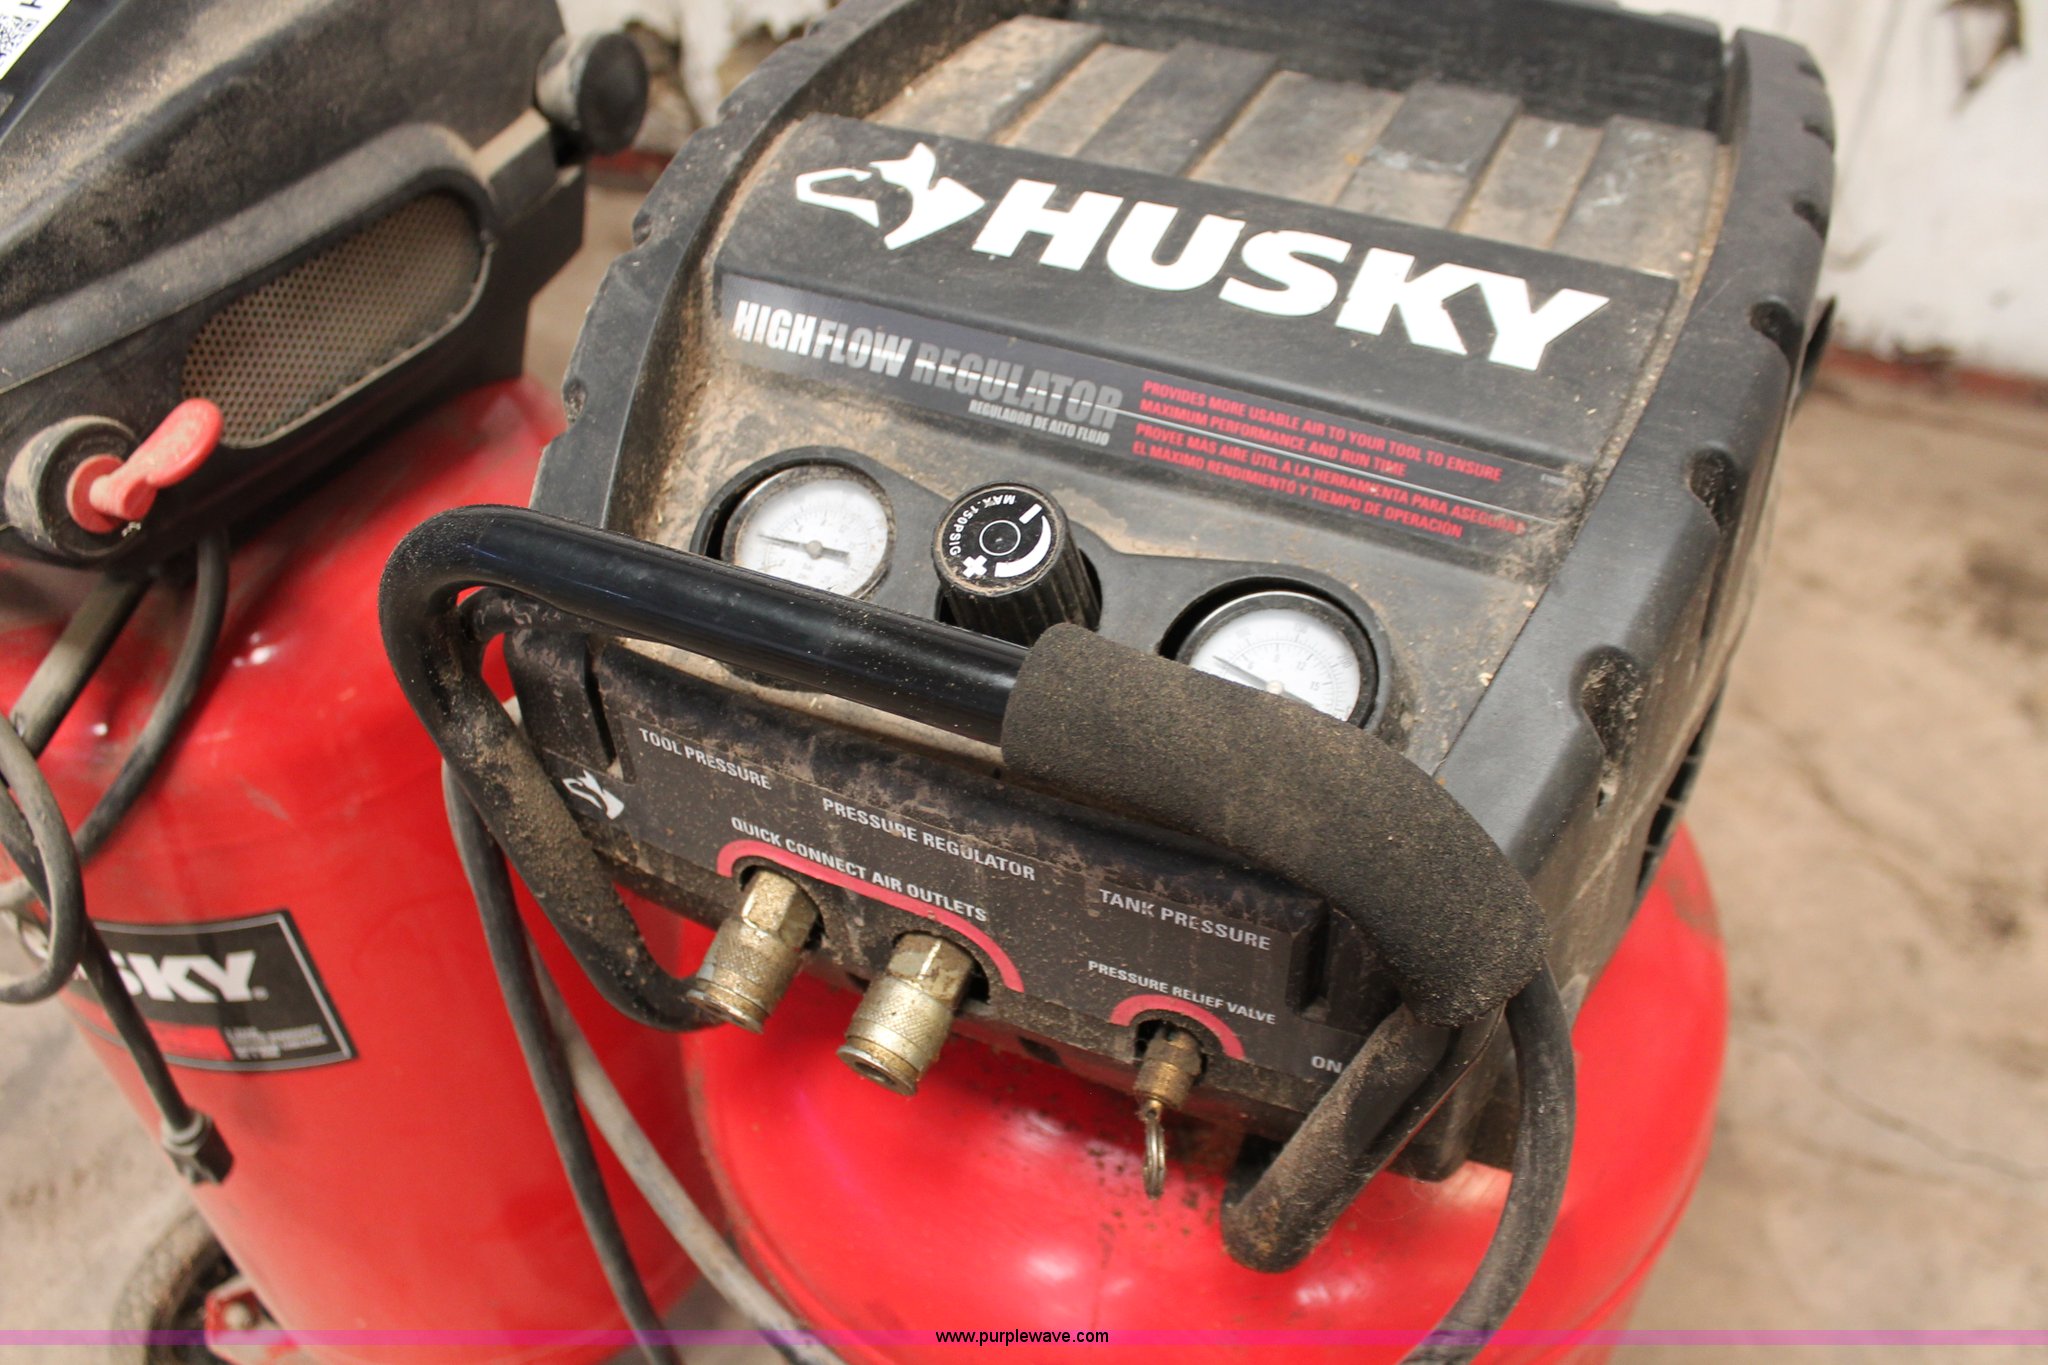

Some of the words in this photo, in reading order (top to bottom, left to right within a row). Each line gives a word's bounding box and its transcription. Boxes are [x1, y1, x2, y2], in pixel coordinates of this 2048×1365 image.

[971, 178, 1610, 372] HUSKY
[909, 342, 1124, 431] REGULATOR
[967, 398, 1033, 428] REGULADOR
[1033, 414, 1049, 430] DE
[1048, 418, 1076, 438] ALTO
[1076, 424, 1110, 447] FLUJO
[1135, 421, 1184, 447] PROVEE
[1218, 443, 1249, 463] AIRE
[1280, 459, 1292, 474] A
[1293, 462, 1311, 479] LA
[1311, 467, 1409, 505] HERRAMIENTA
[1410, 492, 1449, 516] PARA
[1139, 398, 1209, 427] MAXIMUM
[1209, 415, 1308, 452] PERFORMANCE
[1307, 440, 1340, 460] AND
[1339, 447, 1371, 469] RUN
[1372, 455, 1408, 478] TIME
[1141, 379, 1207, 408] PROVIDES
[1207, 395, 1248, 418] MORE
[1248, 406, 1300, 431] USABLE
[1301, 418, 1327, 438] AIR
[1328, 425, 1345, 442] TO
[1349, 430, 1387, 452] YOUR
[1388, 439, 1423, 463] TOOL
[1426, 449, 1444, 467] TO
[1445, 455, 1504, 483] ENSURE
[1132, 440, 1147, 457] EL
[1206, 459, 1297, 495] RENDIMIENTO
[1298, 482, 1309, 497] Y
[1311, 485, 1362, 512] TIEMPO
[1363, 501, 1383, 517] DE
[948, 505, 980, 557] 150PSIG
[638, 727, 683, 756] TOOL
[684, 745, 772, 790] PRESSURE
[730, 816, 782, 848] QUICK
[785, 838, 867, 880] CONNECT
[872, 871, 903, 893] AIR
[906, 883, 988, 923] OUTLETS
[822, 797, 919, 843] PRESSURE
[922, 831, 1036, 881] REGULATOR
[1098, 888, 1155, 919] TANK
[1160, 906, 1272, 951] PRESSURE
[1087, 959, 1169, 994] PRESSURE
[1172, 985, 1224, 1009] RELIEF
[1226, 1001, 1277, 1025] VALVE
[1310, 1054, 1343, 1074] ON
